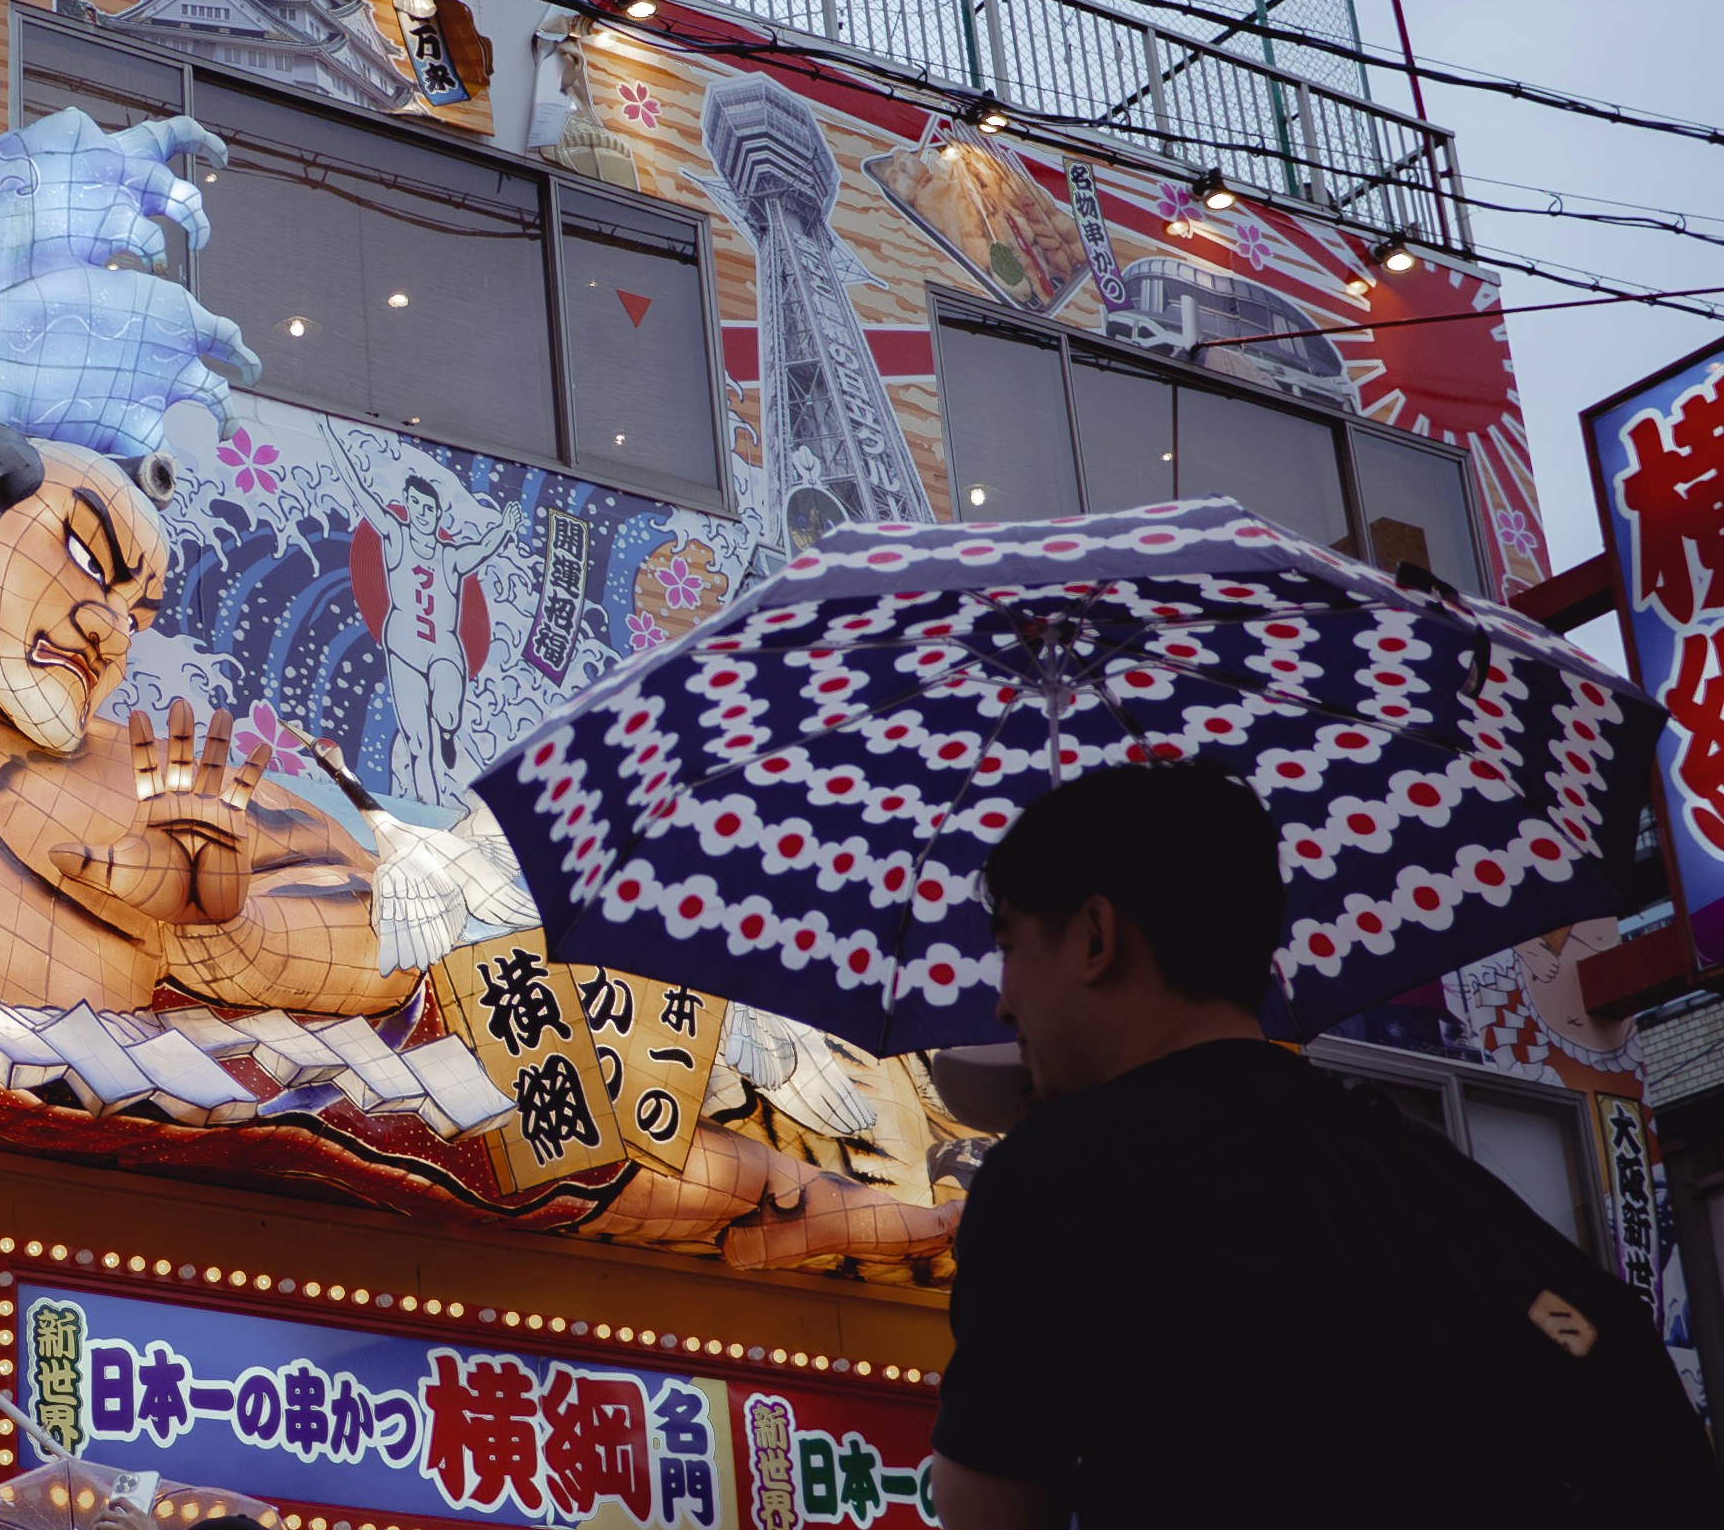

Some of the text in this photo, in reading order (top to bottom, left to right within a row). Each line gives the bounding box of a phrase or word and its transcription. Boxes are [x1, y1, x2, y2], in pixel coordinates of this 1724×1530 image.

[412, 564, 437, 644] グリコ
[535, 515, 584, 669] 開運招福
[477, 948, 601, 1168] 横綱
[35, 1307, 80, 1455] 新世界
[90, 1345, 652, 1524] 日本一の串かつ 横綱
[654, 1387, 717, 1528] 名門
